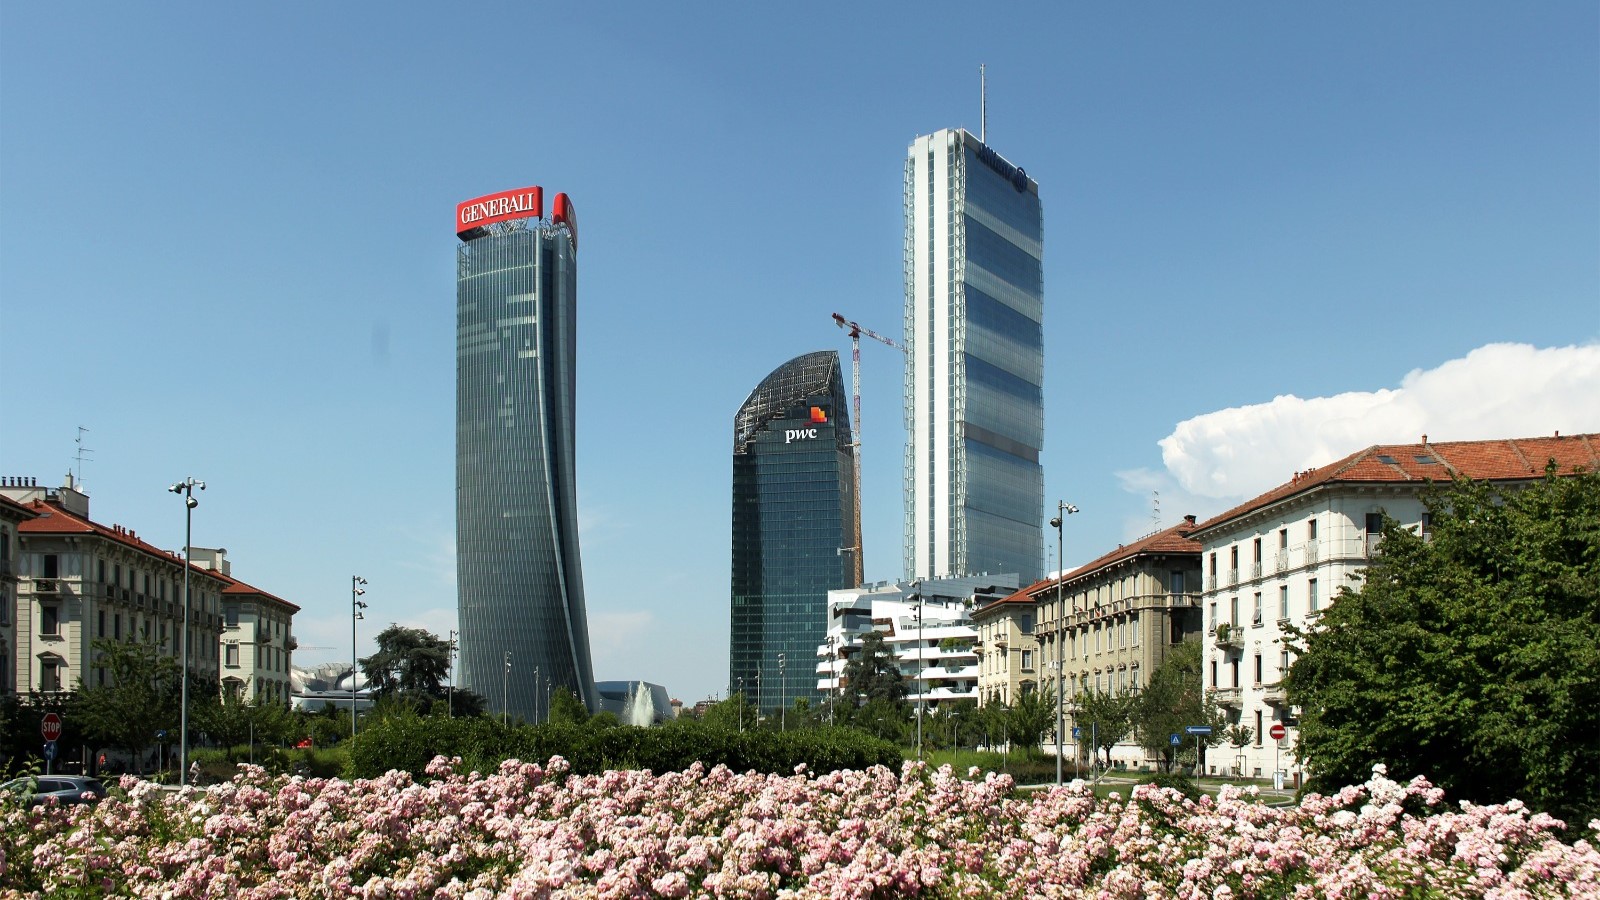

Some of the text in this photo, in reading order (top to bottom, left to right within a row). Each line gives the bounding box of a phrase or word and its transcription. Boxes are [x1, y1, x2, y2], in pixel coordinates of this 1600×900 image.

[461, 192, 534, 224] GENERALI
[785, 428, 817, 444] pwc
[43, 722, 60, 732] STOP
